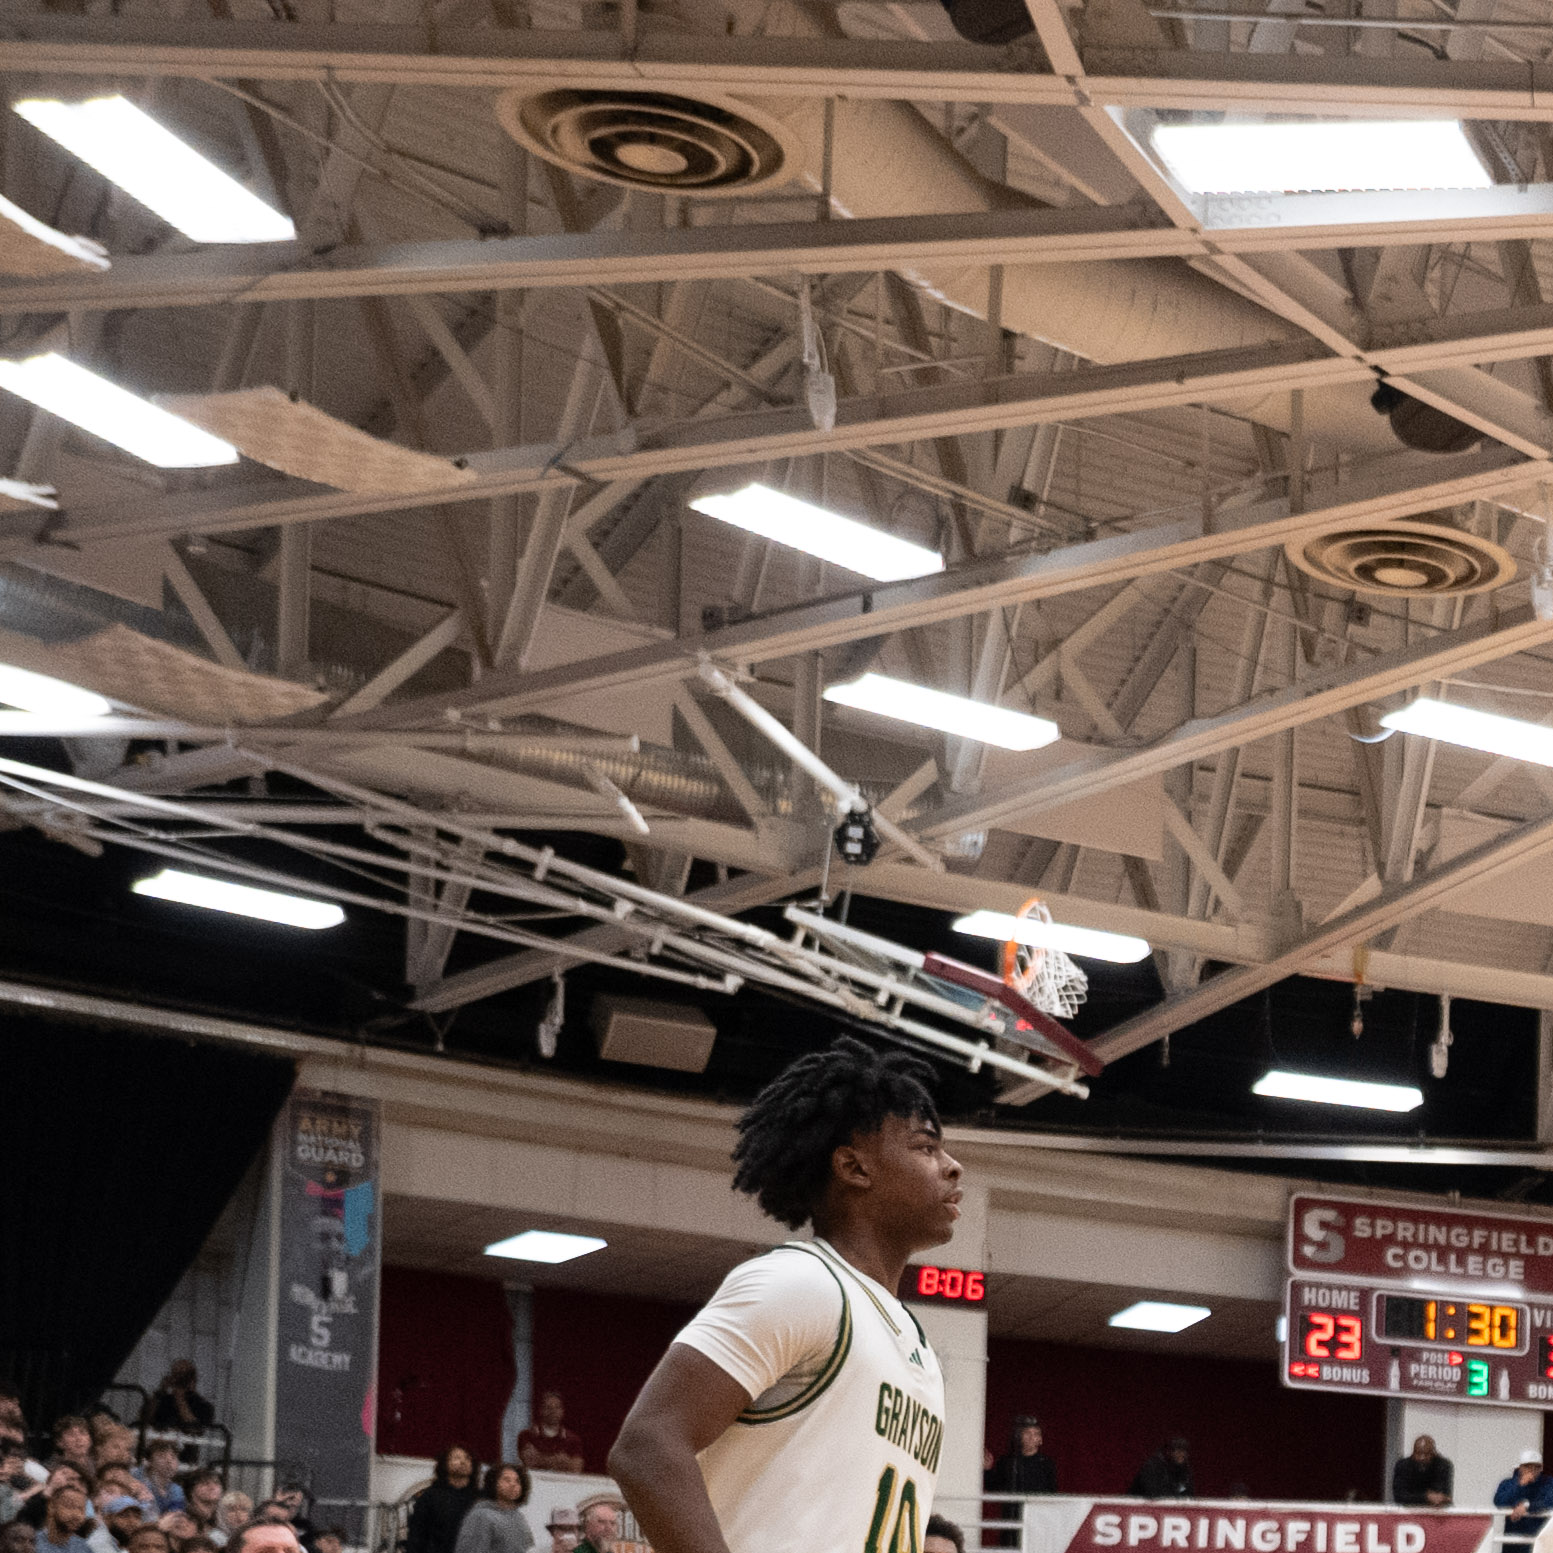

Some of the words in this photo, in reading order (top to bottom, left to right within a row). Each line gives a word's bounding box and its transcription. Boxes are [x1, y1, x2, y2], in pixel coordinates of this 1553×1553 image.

[299, 1144, 365, 1168] GUARD
[1386, 1248, 1525, 1281] COLLEGE
[918, 1266, 984, 1300] 8:06
[1303, 1287, 1360, 1311] HOME
[1305, 1312, 1362, 1361] 23
[1425, 1300, 1518, 1348] 1:30
[1322, 1365, 1371, 1385] BONUS
[1410, 1363, 1462, 1383] PERIOD
[1467, 1358, 1490, 1397] 3
[875, 1381, 944, 1475] GRAYSON
